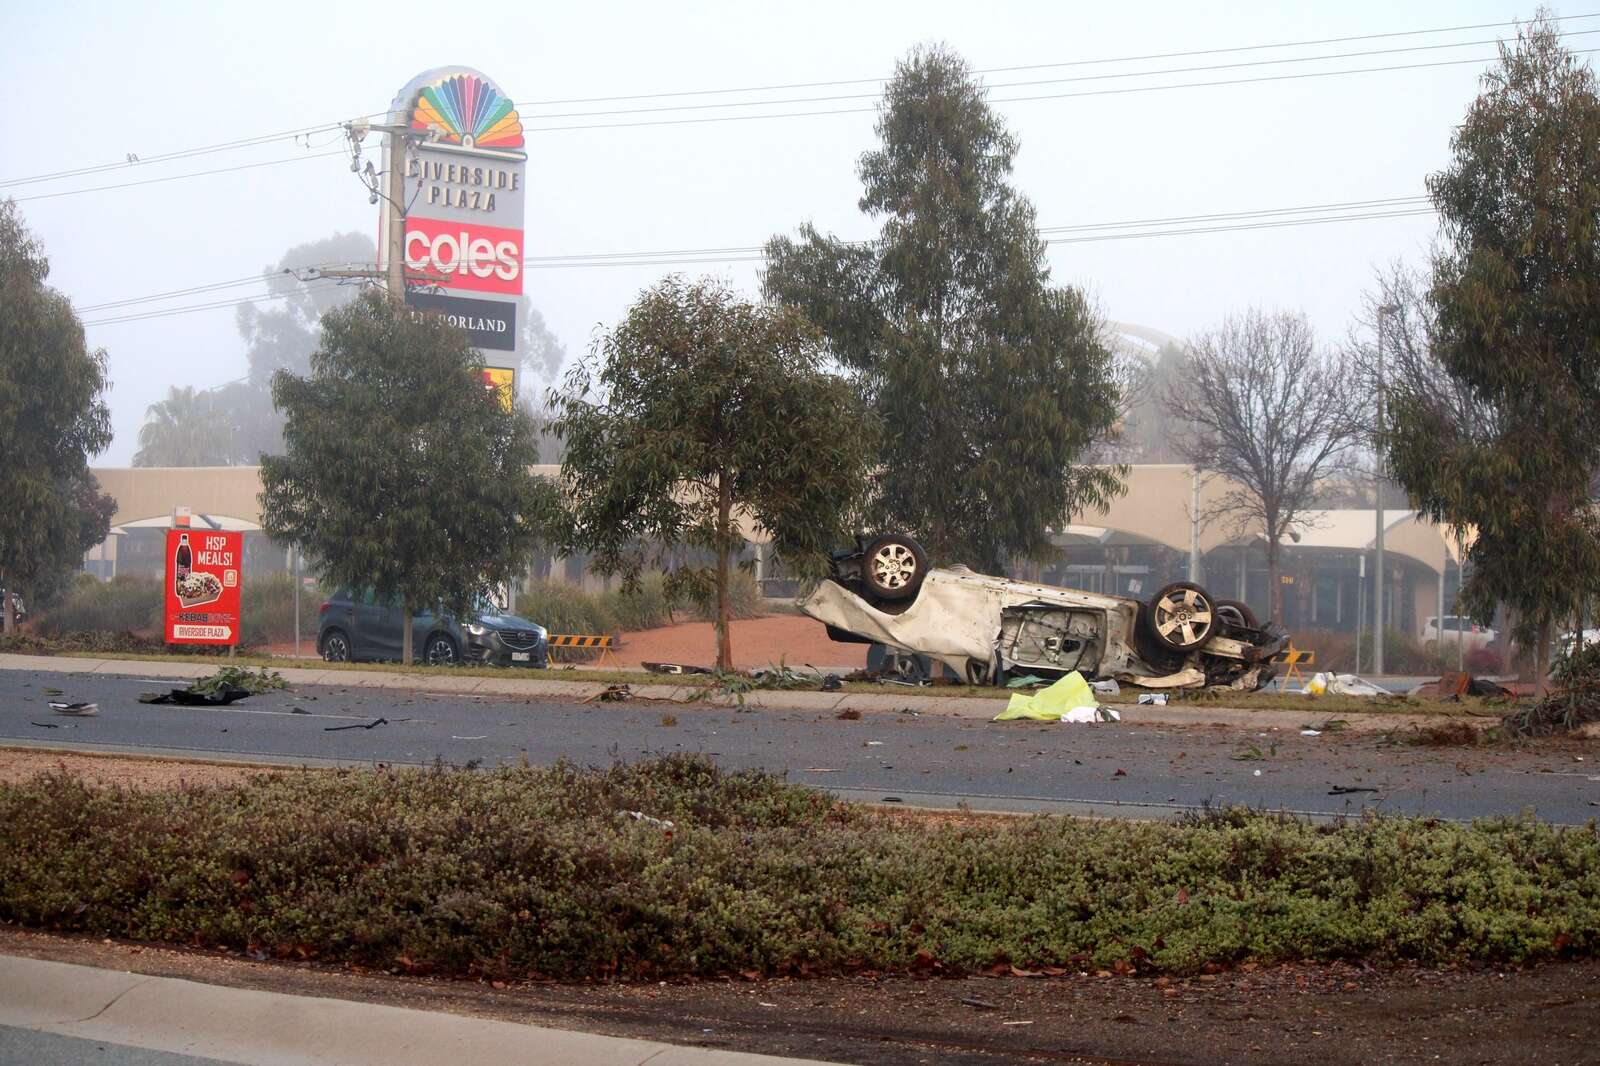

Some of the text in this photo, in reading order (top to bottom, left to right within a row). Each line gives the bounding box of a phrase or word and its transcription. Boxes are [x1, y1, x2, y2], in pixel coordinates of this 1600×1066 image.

[427, 185, 496, 212] PLAZA
[405, 230, 519, 281] coles
[205, 536, 227, 551] HSP
[197, 551, 233, 566] MEALS!
[178, 626, 225, 638] RIVERSIDE PLAZA
